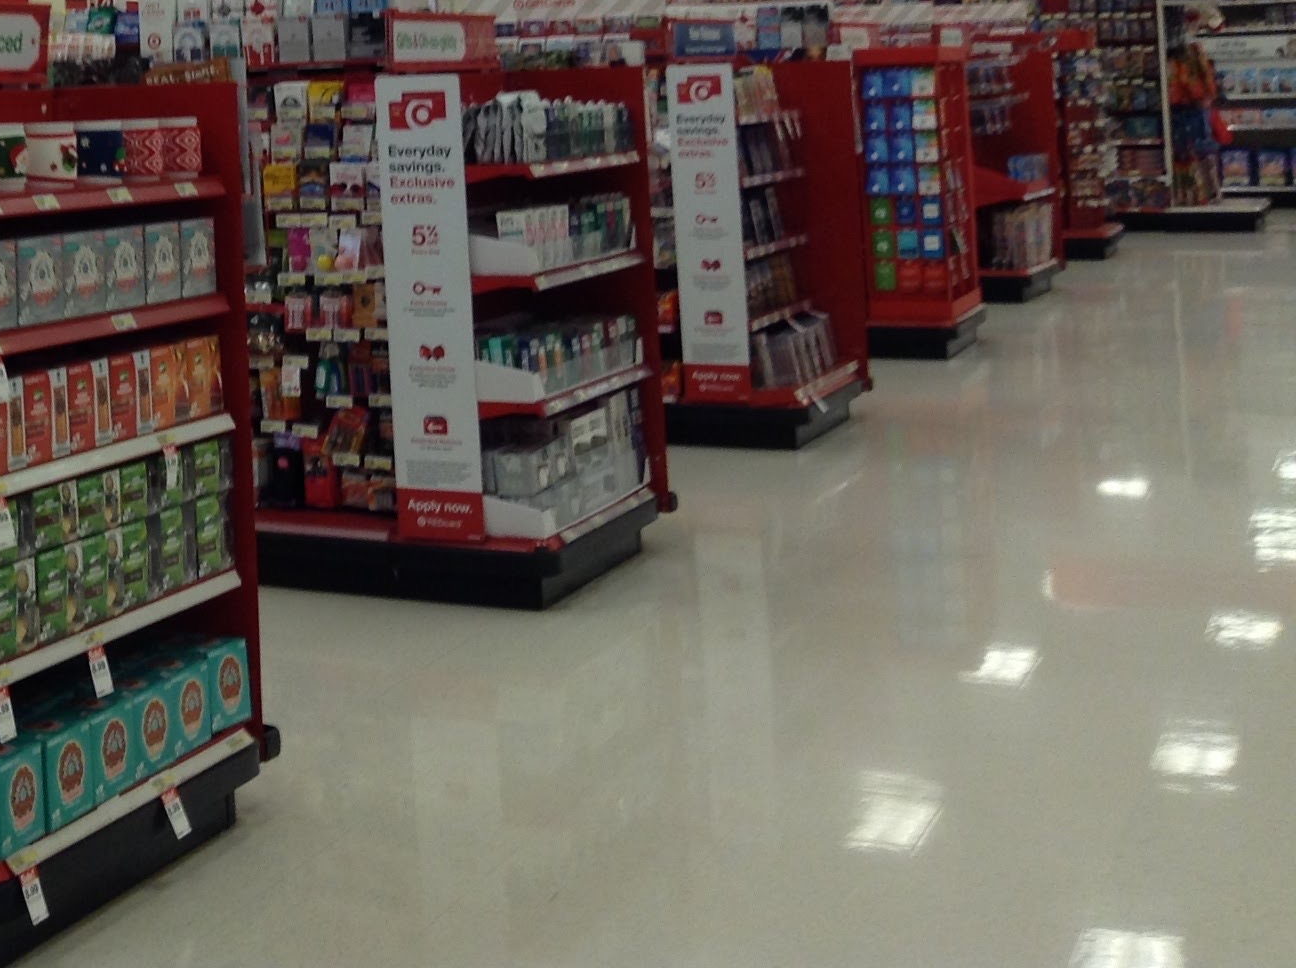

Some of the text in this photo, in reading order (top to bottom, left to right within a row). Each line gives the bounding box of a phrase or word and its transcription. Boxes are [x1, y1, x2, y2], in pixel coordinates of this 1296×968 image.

[388, 144, 451, 161] Everyday
[388, 161, 446, 176] savings.
[390, 177, 455, 189] Exclusive
[390, 192, 437, 205] extras.
[407, 497, 473, 514] Apply now.
